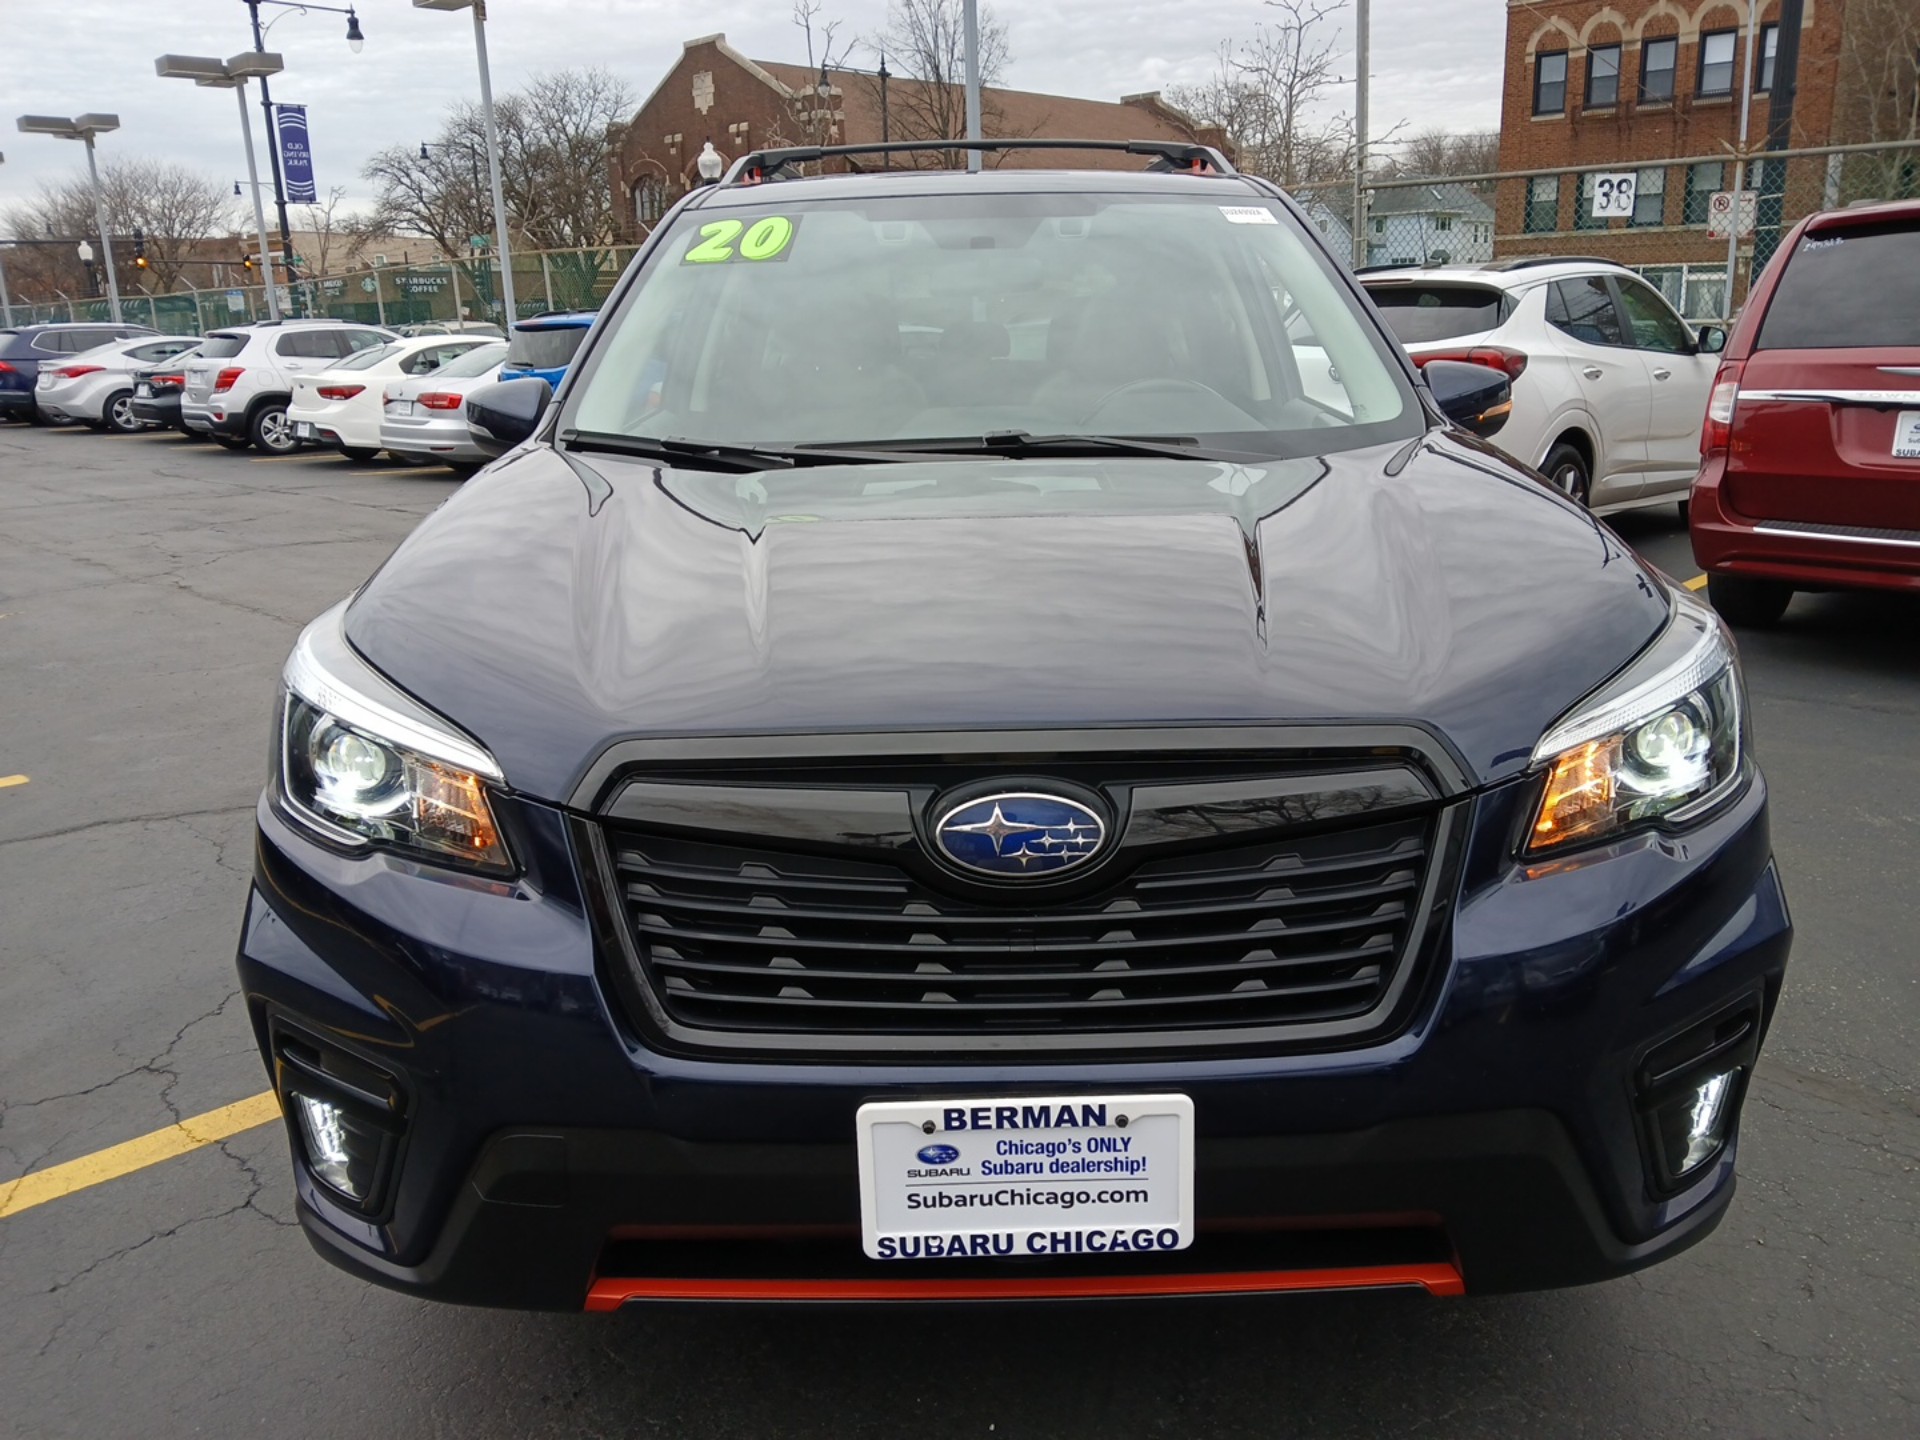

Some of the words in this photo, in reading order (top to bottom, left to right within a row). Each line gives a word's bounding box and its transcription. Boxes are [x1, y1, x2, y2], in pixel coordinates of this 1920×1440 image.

[1597, 178, 1633, 212] 38
[684, 215, 793, 263] 20
[943, 1104, 1107, 1131] BERMAN
[996, 1138, 1082, 1157] Chicago's
[1086, 1136, 1132, 1153] ONLY
[906, 1167, 971, 1178] SUBARU
[980, 1159, 1044, 1176] Subaru
[1049, 1156, 1147, 1175] dealership!
[906, 1188, 1149, 1210] SubaruChicago.com
[876, 1232, 1014, 1258] SUBARU
[1026, 1228, 1180, 1254] CHICAGO
